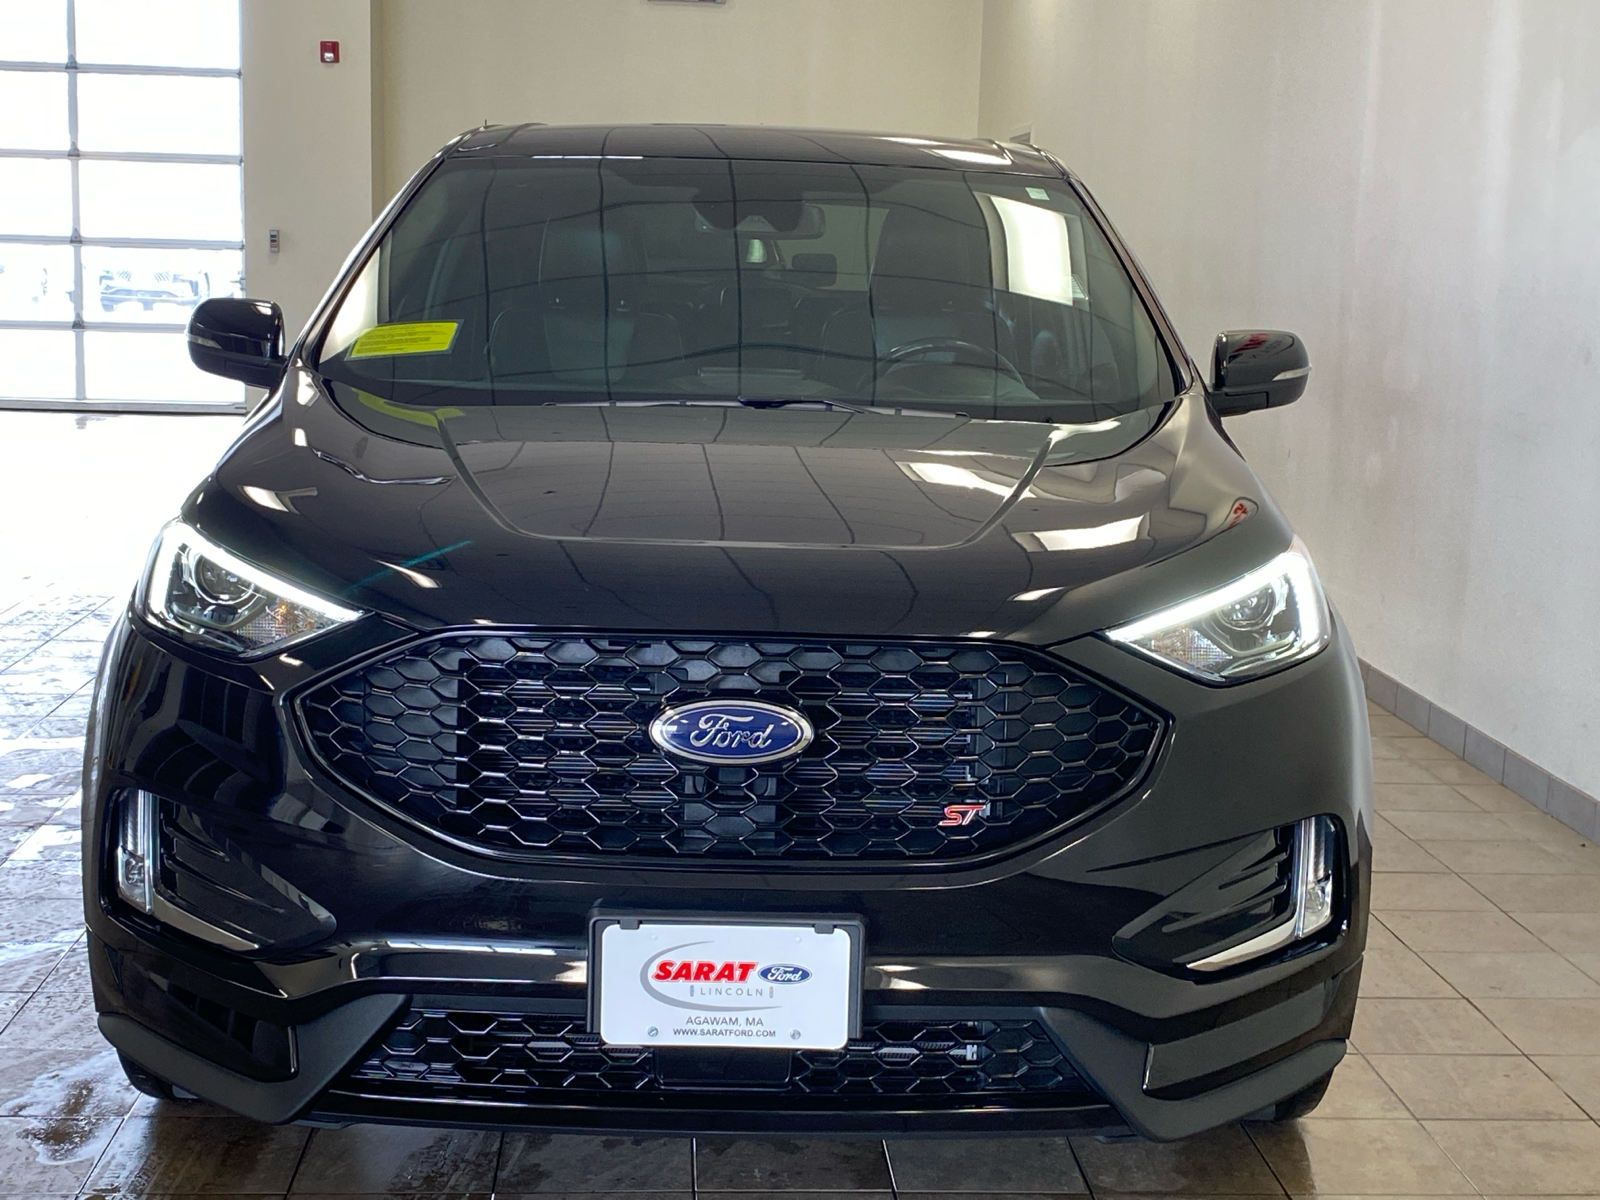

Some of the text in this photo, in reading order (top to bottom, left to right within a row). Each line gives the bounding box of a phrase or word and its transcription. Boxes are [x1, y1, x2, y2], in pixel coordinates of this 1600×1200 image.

[690, 713, 774, 748] Ford
[938, 805, 986, 826] ST
[651, 960, 803, 983] SARAT Ford
[700, 987, 763, 996] LINCOLN
[685, 1016, 764, 1027] AGAWAM, MA
[673, 1028, 776, 1037] WWW.SARATFORD.COM
